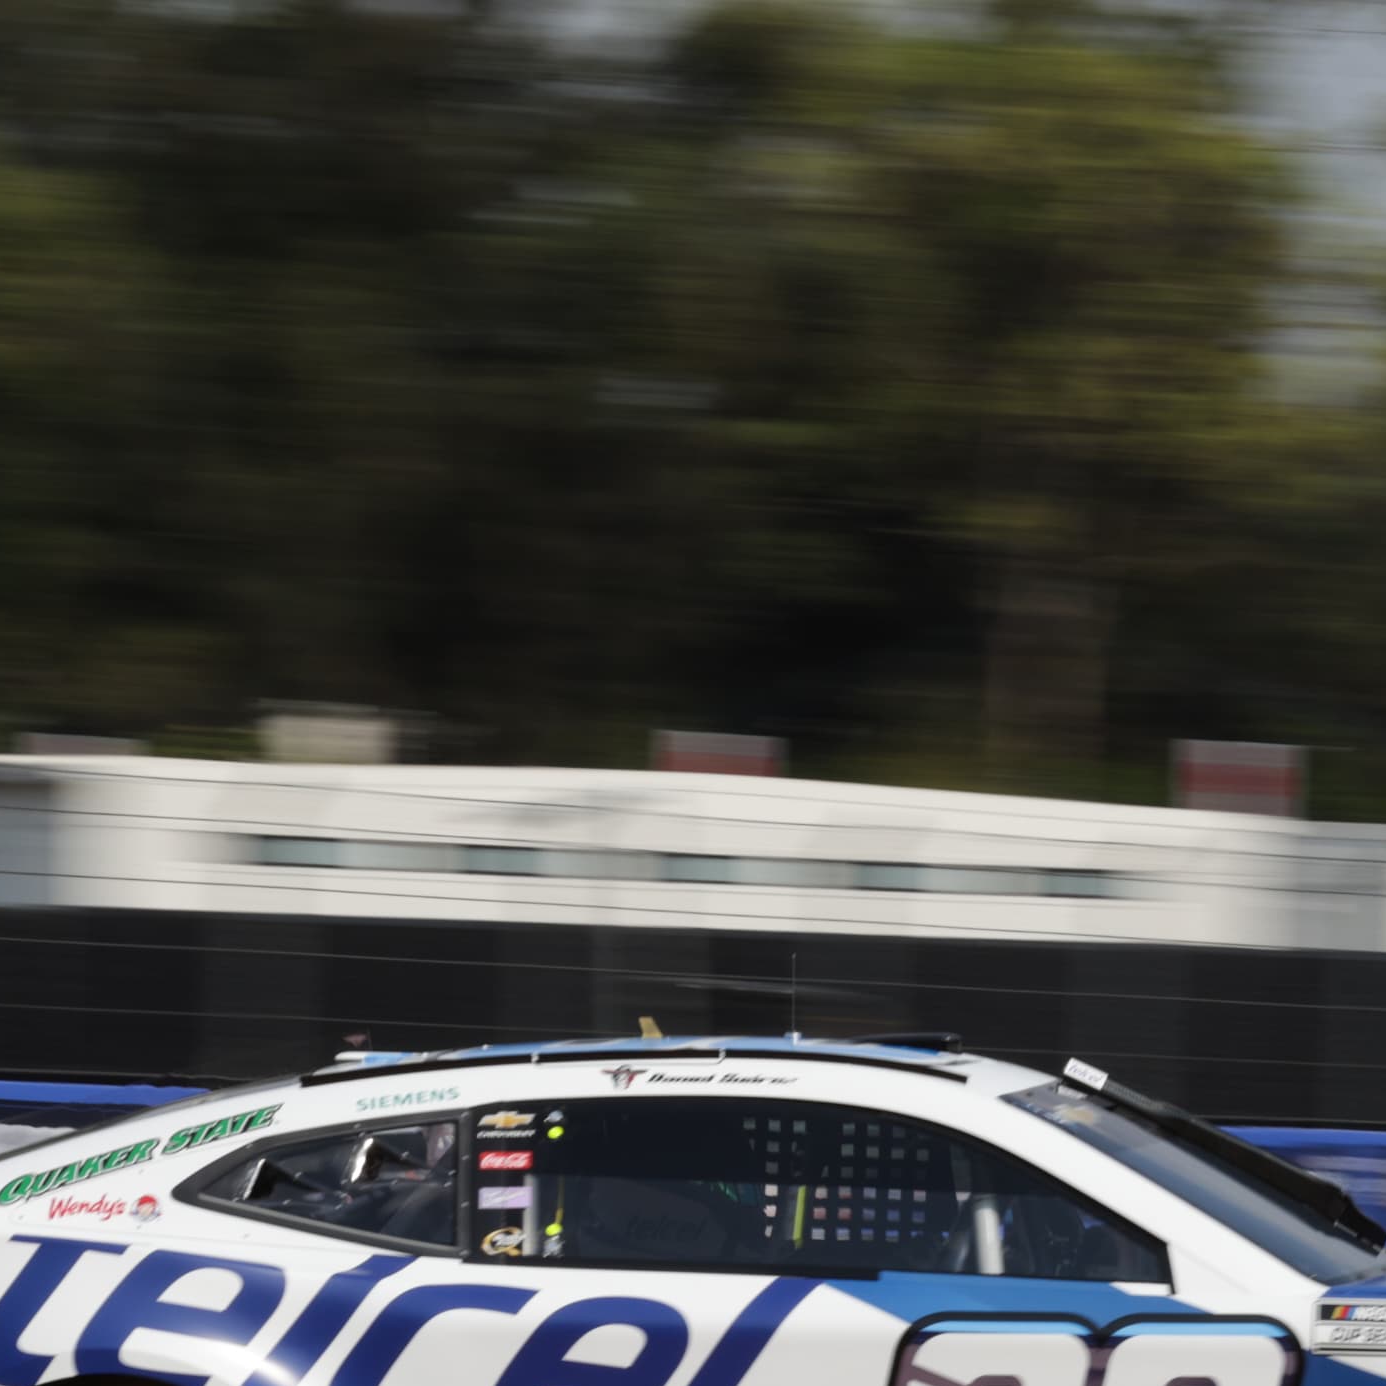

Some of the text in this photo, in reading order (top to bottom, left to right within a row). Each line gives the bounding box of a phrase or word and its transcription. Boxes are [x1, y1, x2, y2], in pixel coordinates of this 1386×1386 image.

[356, 1086, 460, 1112] SIEMENS
[161, 1103, 285, 1155] STATE
[48, 1194, 126, 1221] Wendy's
